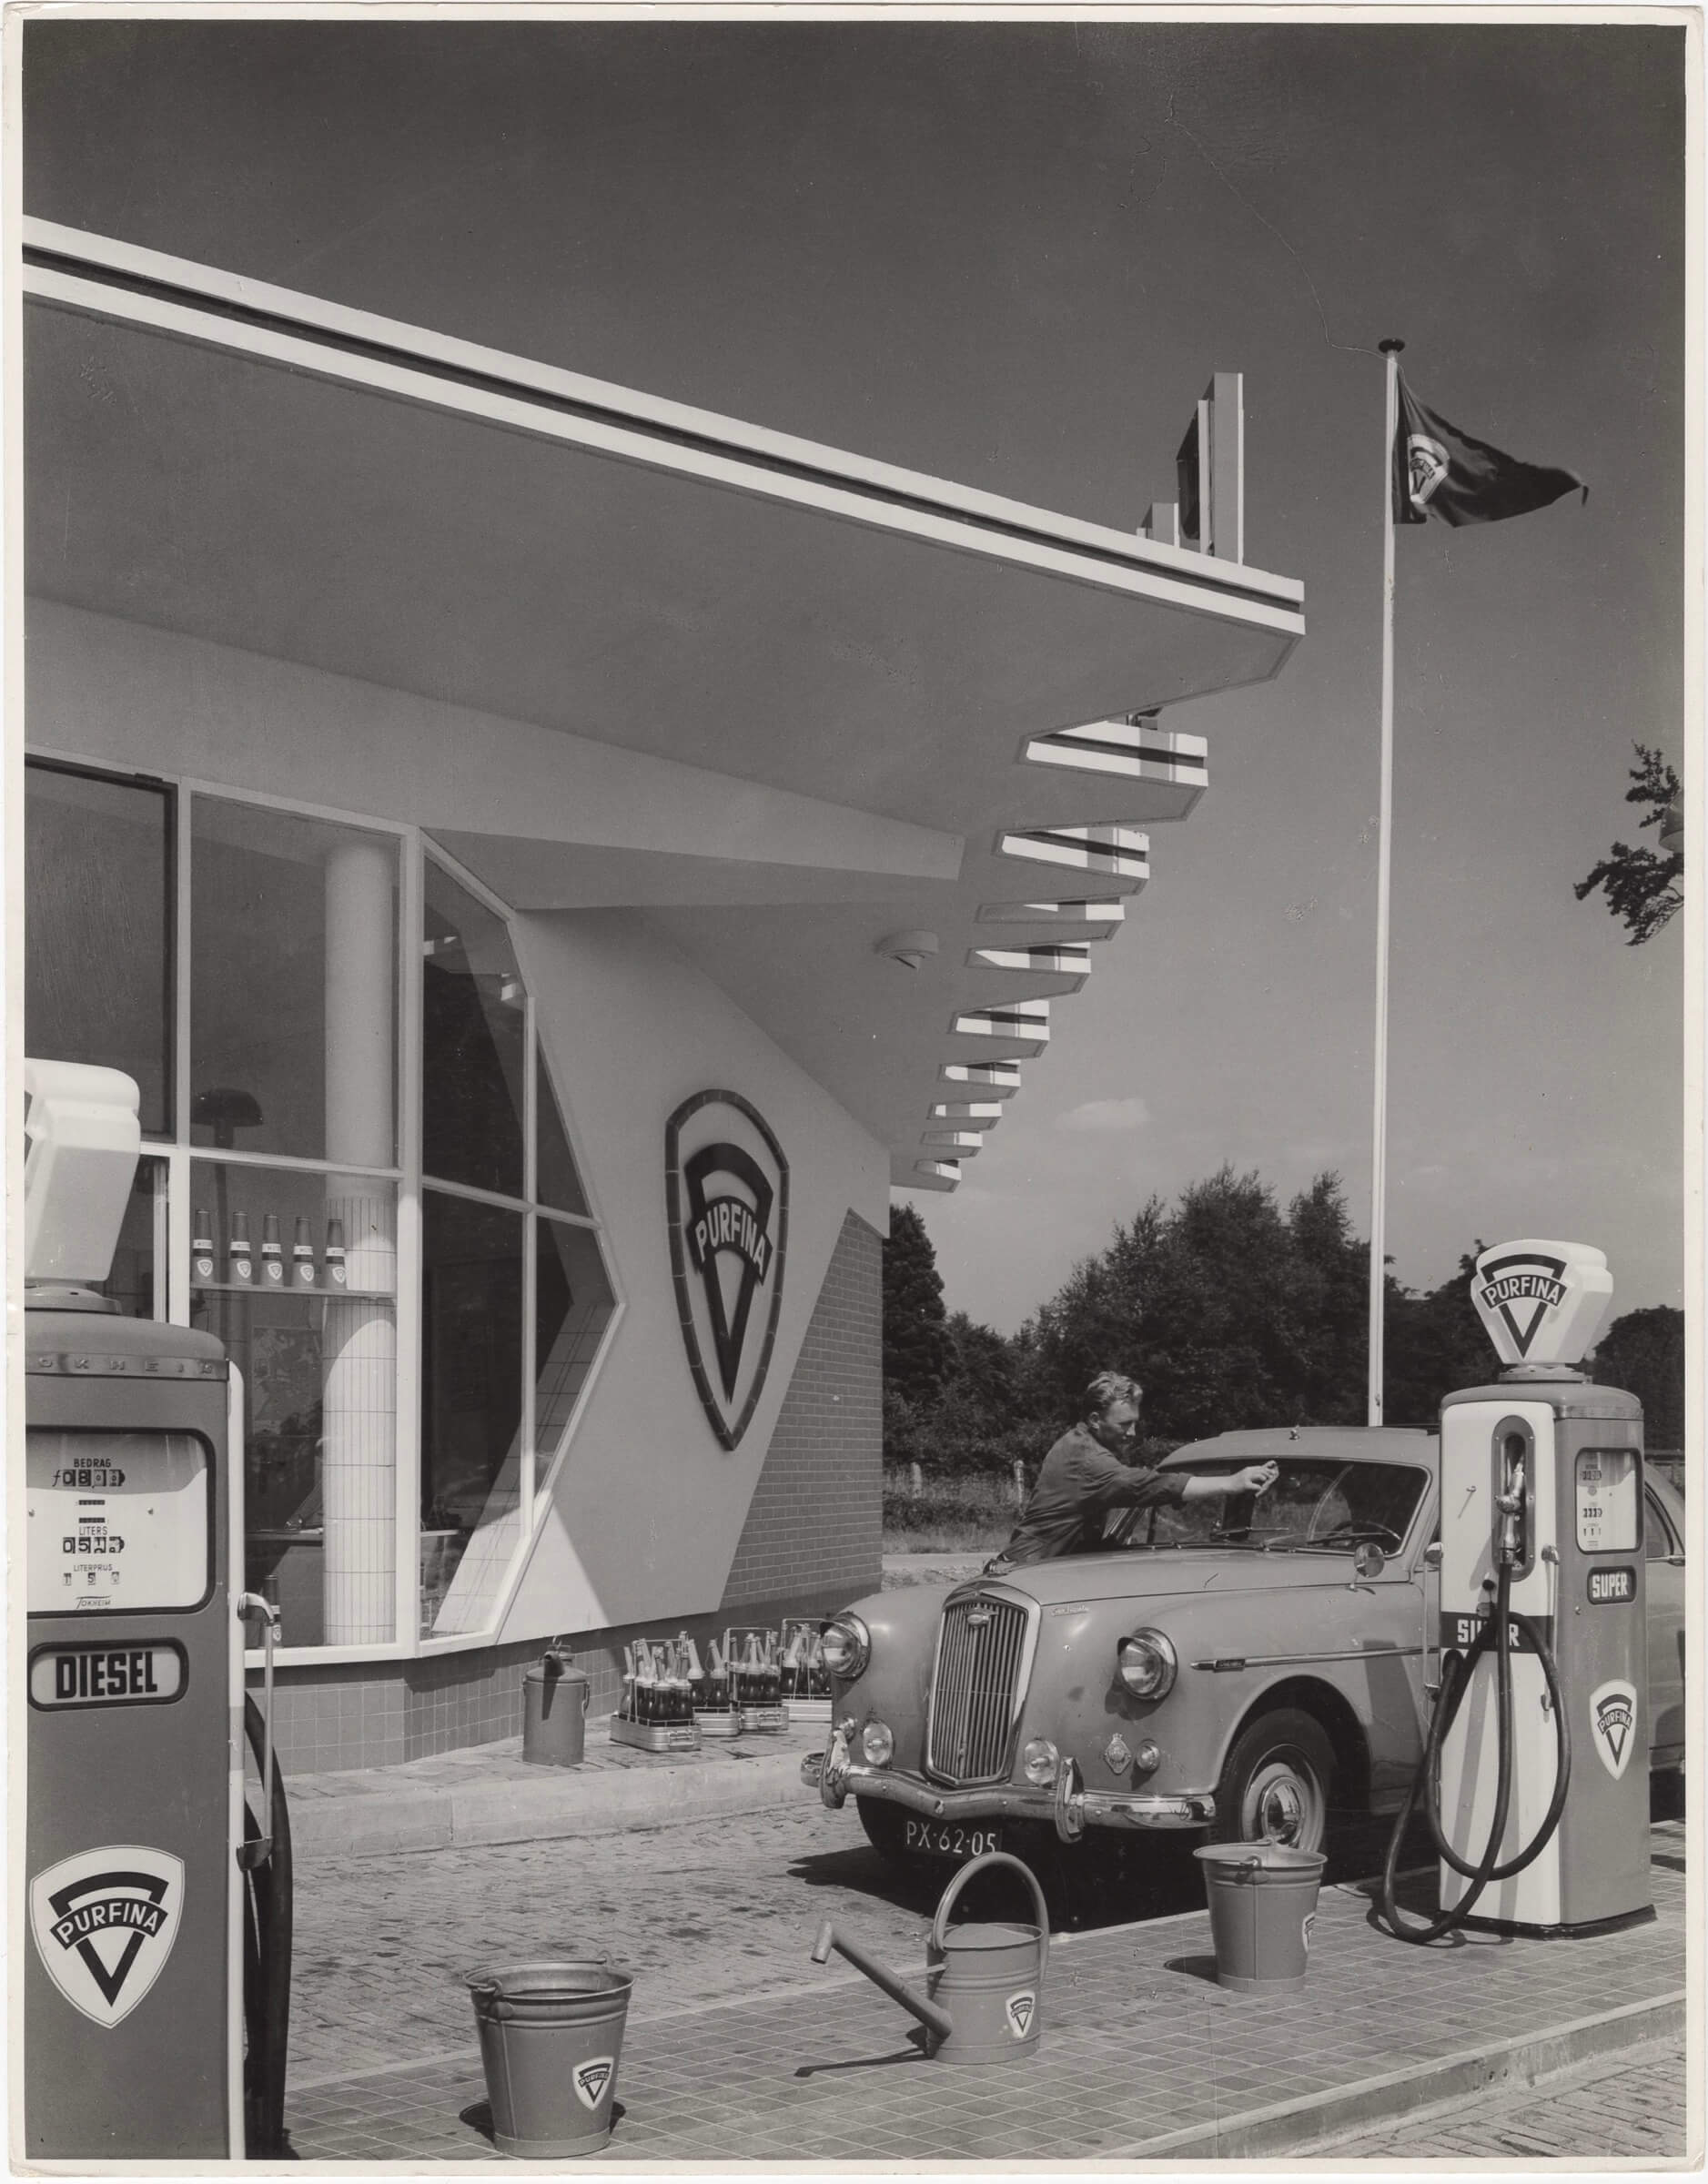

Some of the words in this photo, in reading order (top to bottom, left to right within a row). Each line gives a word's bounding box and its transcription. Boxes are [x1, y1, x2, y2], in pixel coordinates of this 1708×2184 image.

[695, 1202, 765, 1277] PURFINA
[1484, 1276, 1561, 1306] PURFINA
[74, 1458, 111, 1468] BEDRAG
[79, 1526, 108, 1536] LITERS
[1592, 1572, 1628, 1598] SUPER
[1458, 1619, 1521, 1646] SUR
[56, 1651, 157, 1699] DIESEL
[1599, 1711, 1632, 1732] PURFINA
[56, 1902, 160, 1944] PURFINA
